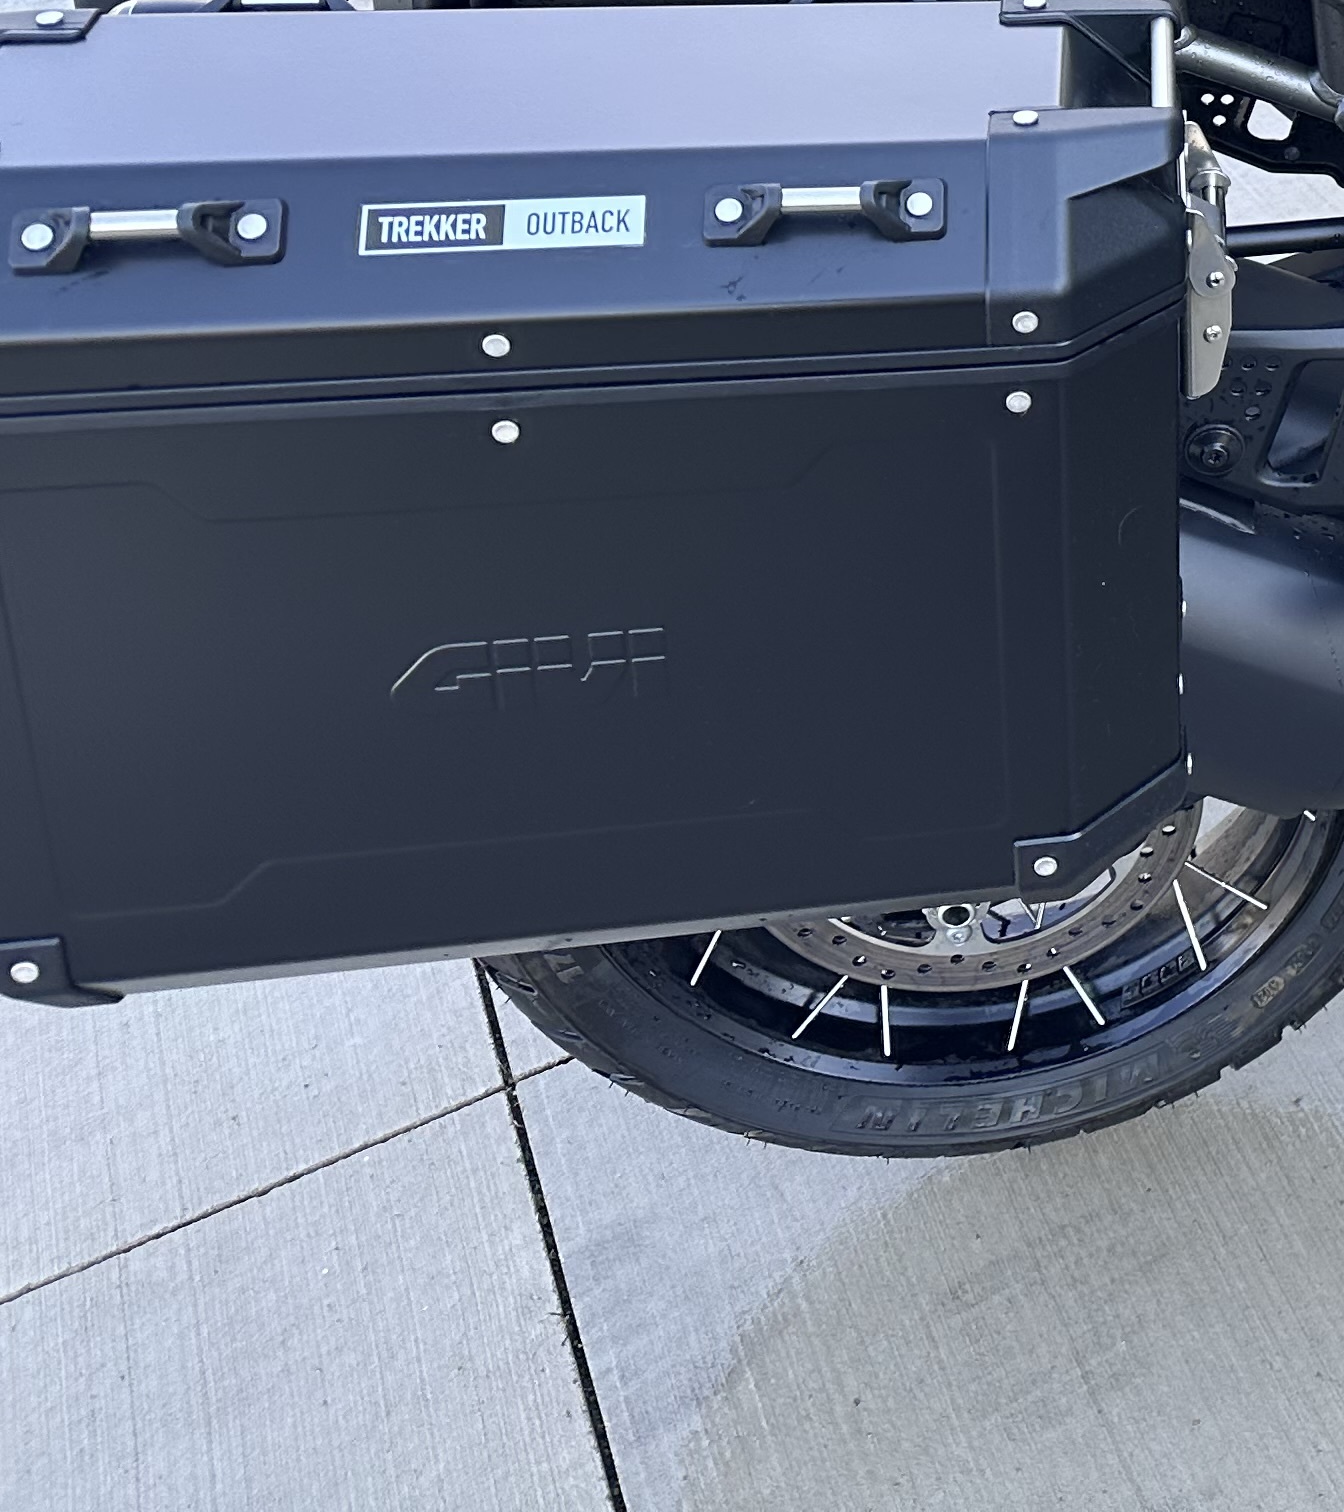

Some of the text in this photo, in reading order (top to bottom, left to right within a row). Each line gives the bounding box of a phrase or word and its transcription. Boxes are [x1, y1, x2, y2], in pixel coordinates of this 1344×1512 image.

[378, 208, 631, 243] TREKKER OUTBACK
[856, 1051, 1160, 1131] MICHELIN
